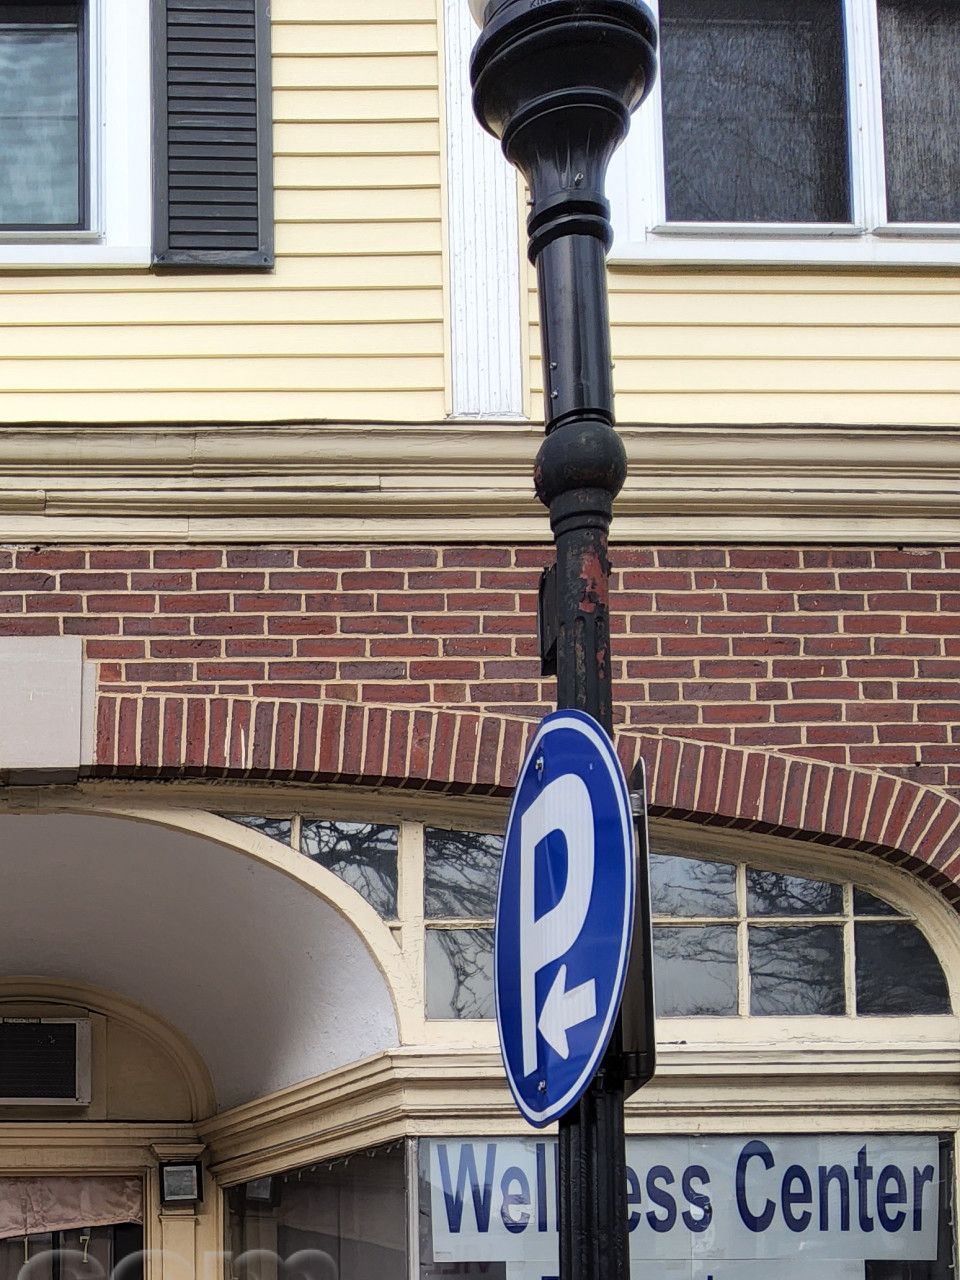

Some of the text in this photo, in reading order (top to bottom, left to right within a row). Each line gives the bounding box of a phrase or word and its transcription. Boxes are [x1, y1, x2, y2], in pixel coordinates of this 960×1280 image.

[520, 773, 595, 1077] P
[437, 1139, 934, 1234] Welless Center
[23, 1235, 31, 1265] 1
[79, 1235, 91, 1264] 7
